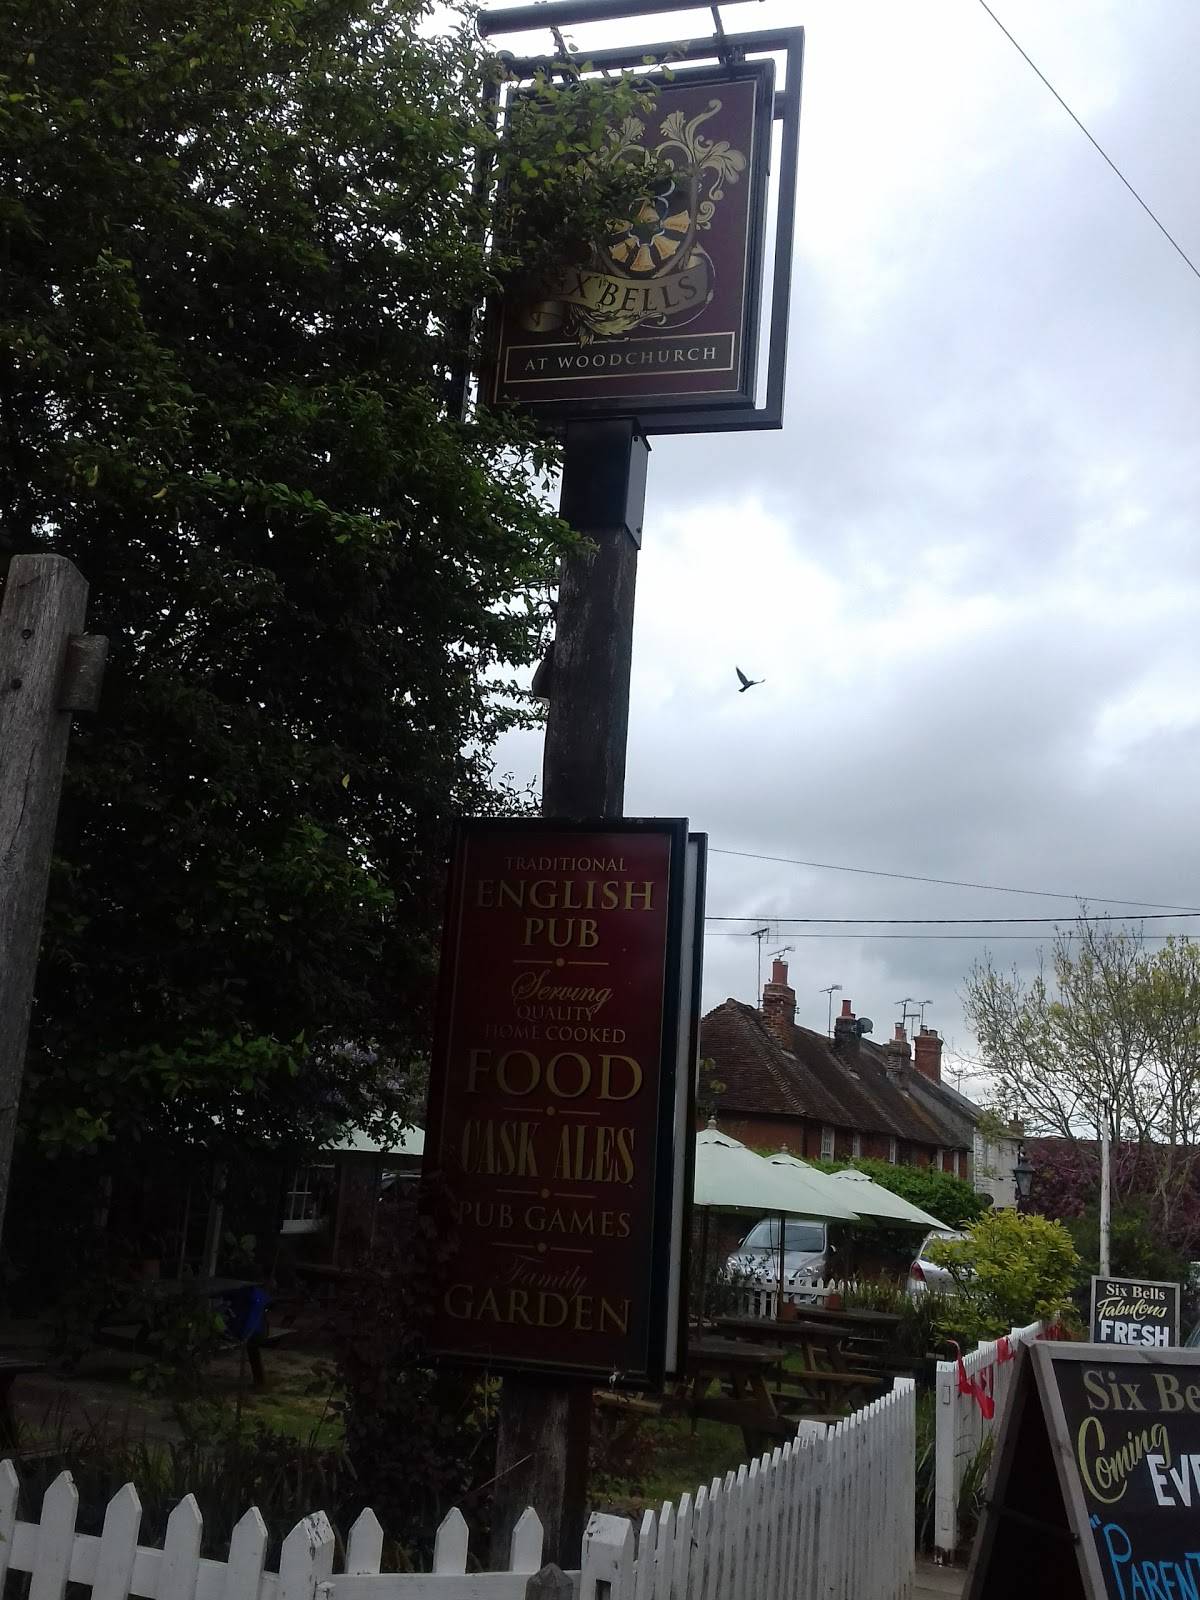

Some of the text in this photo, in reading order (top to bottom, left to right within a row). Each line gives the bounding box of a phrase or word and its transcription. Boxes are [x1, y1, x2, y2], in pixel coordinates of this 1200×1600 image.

[599, 276, 698, 313] BELLS
[525, 347, 716, 371] AT WOODCHURCH
[504, 856, 627, 872] TRADITIONAL
[477, 879, 655, 911] ENGLISH
[522, 917, 600, 949] PUB
[511, 968, 613, 1013] Serving
[517, 1004, 596, 1023] QUALITY
[484, 1023, 627, 1044] HOME COOKED
[464, 1048, 643, 1101] FOOD
[462, 1119, 637, 1185] CASK ALES
[457, 1200, 632, 1239] PUB GAMES
[500, 1253, 588, 1304] Family
[1106, 1282, 1166, 1301] Six Bells
[444, 1283, 632, 1337] GARDEN
[1096, 1297, 1168, 1322] Fabulous
[1101, 1320, 1169, 1347] FRESH
[1082, 1370, 1147, 1412] Six
[1078, 1416, 1172, 1504] Coming
